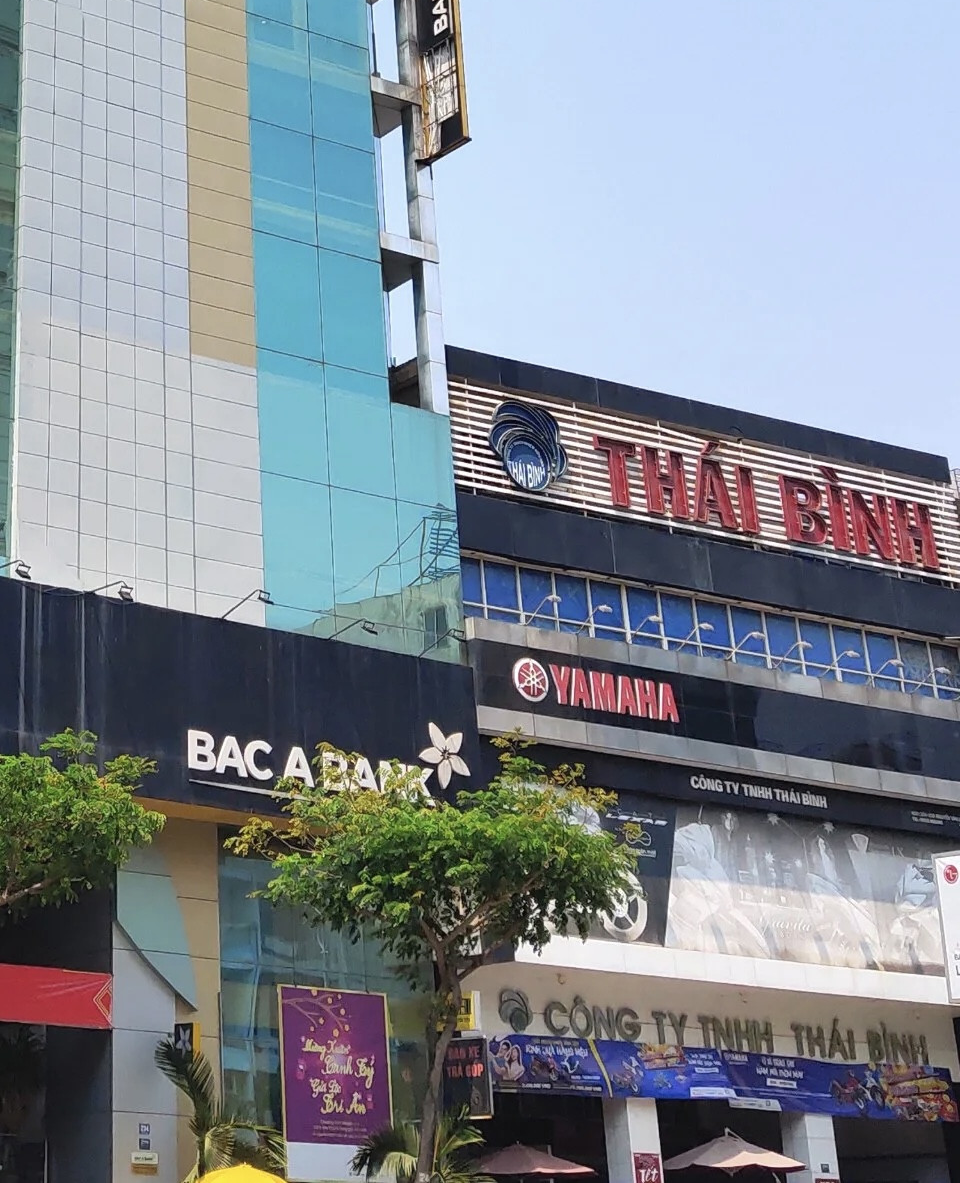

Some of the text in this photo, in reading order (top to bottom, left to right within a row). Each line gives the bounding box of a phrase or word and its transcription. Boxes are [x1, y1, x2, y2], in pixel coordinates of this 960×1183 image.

[507, 459, 546, 488] THÁI BÌNH
[593, 435, 939, 569] THÁI BÌNH
[548, 664, 680, 723] YAMAHA
[188, 729, 436, 808] BAC A BANK
[690, 774, 828, 809] CÔNG TY TNHH THÁI BÌNH
[544, 994, 930, 1065] CÔNG TY TNHH THÁI BÌNH
